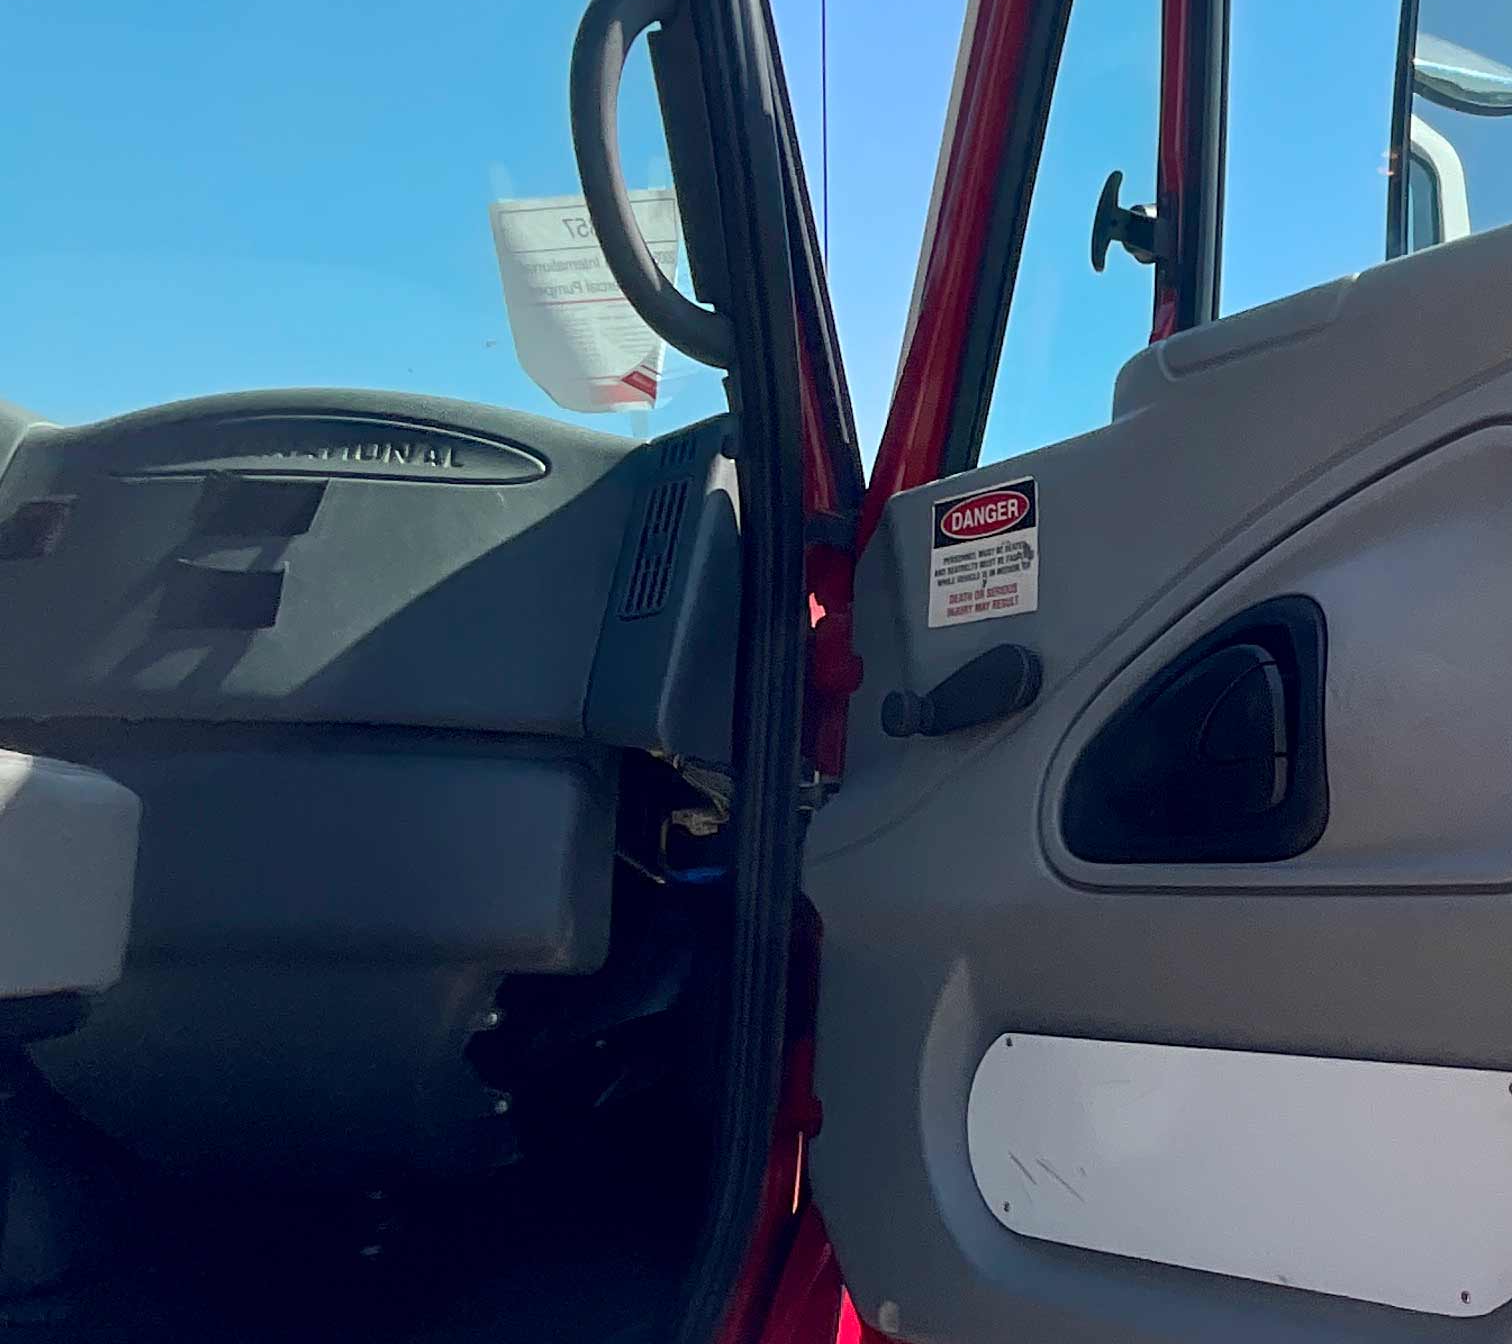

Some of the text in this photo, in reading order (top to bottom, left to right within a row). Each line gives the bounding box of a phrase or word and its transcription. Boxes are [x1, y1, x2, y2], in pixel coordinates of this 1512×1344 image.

[951, 499, 1019, 532] DANGER
[949, 590, 973, 605] DEATH
[986, 583, 1018, 598] SERIOUS
[975, 601, 990, 613] MAY
[992, 595, 1019, 611] RESULT
